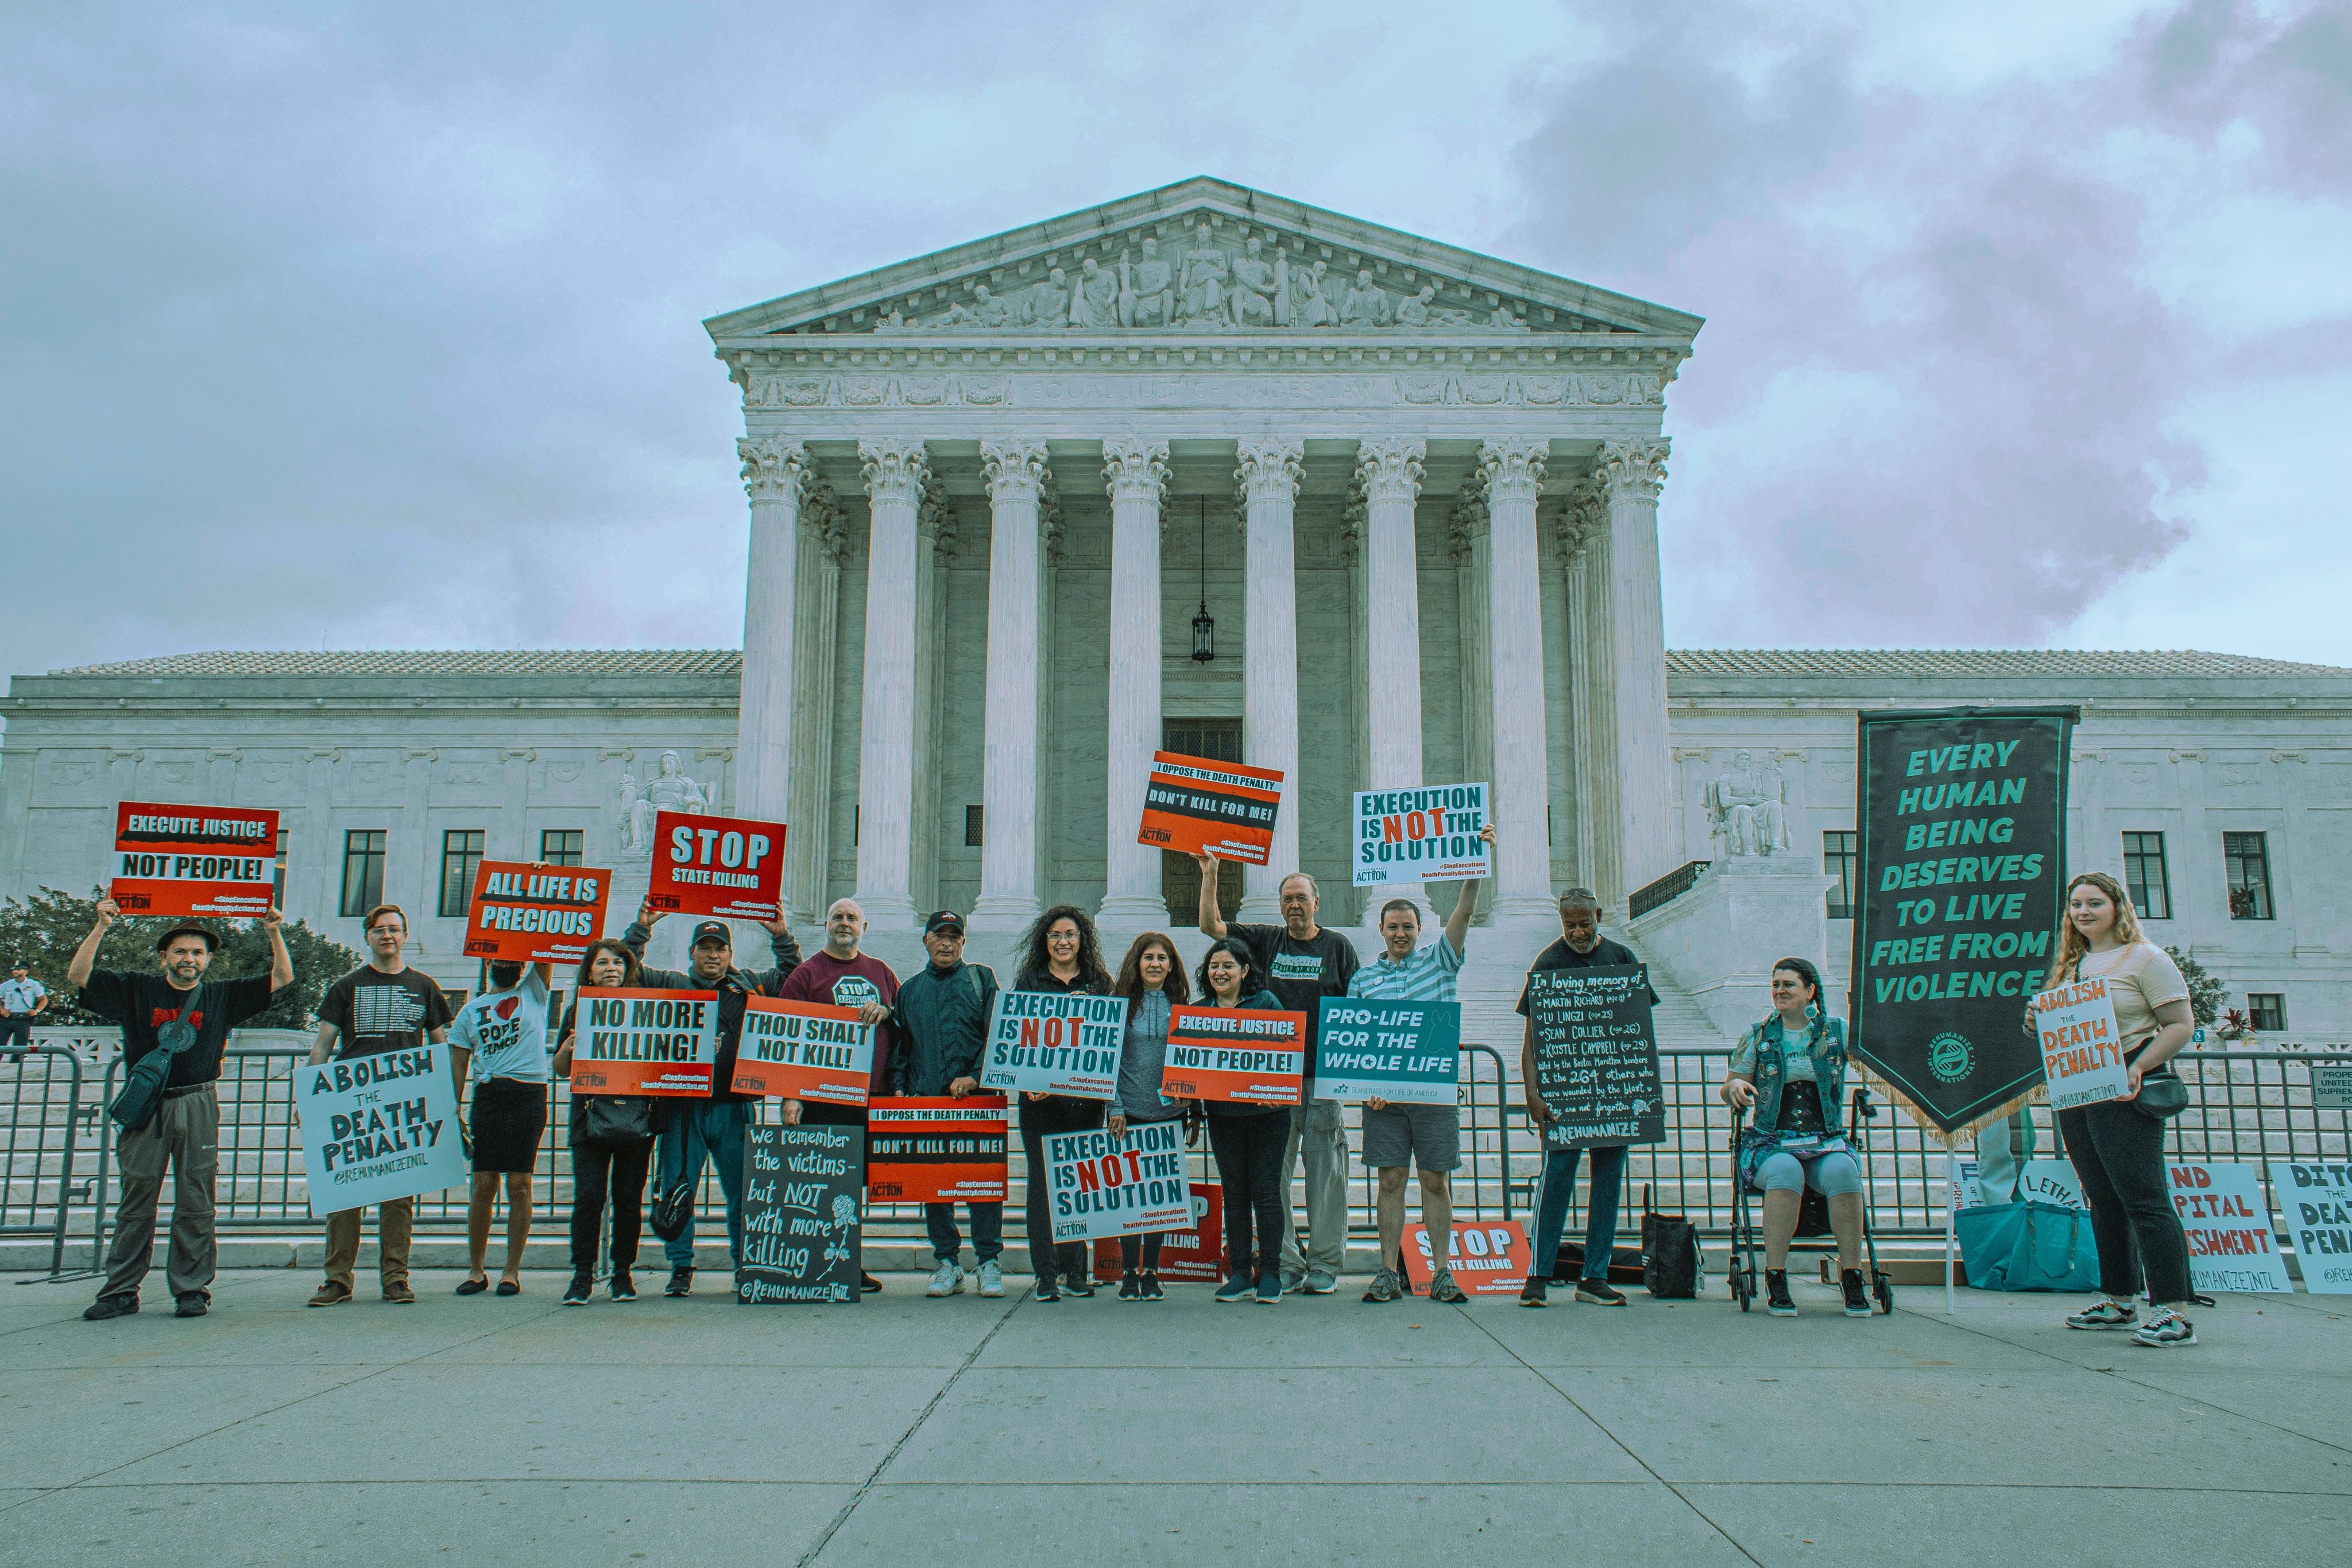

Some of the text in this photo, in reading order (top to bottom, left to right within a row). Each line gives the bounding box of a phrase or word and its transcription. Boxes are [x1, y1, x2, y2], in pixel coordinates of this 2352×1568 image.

[1033, 380, 1375, 400] EQUAL JUSTICE UNDER LAW
[1906, 740, 2020, 777] EVERY
[1157, 764, 1275, 790] I OPPOSE THE DEATH PENALTY
[1149, 789, 1273, 821] DON'T KILL FOR ME!
[1362, 787, 1481, 815] EXECUTION
[1898, 778, 2026, 815] HUMAN
[129, 815, 266, 837] EXECUTE JUSTICE
[1140, 829, 1171, 843] ACTION
[1361, 807, 1481, 845] IS NOT THE
[1905, 817, 2014, 851] BEING
[671, 826, 770, 869] STOP
[1202, 844, 1264, 861] DeathPenaltyAction.org
[1221, 840, 1265, 853] #StopExecutions
[1361, 835, 1483, 864] SOLUTION
[122, 854, 264, 880] NOT PEOPLE!
[672, 868, 759, 889] STATE KILLING
[1356, 870, 1387, 882] ACTION
[1422, 869, 1486, 878] DeathPenaltyAction.org
[1880, 854, 2044, 892] DESERVES
[485, 872, 598, 901] ALL LIFE IS
[480, 905, 593, 936] PRECIOUS
[1897, 893, 2026, 927] TO LIVE
[1870, 931, 2049, 966] FREE FROM
[840, 983, 870, 995] STOP
[1532, 970, 1643, 994] In loving memory of
[1875, 970, 2044, 1003] VIOLENCE
[838, 994, 877, 1004] EXECUTIONS
[1002, 993, 1123, 1023] EXECUTION
[1543, 997, 1571, 1008] MARTIN
[1574, 995, 1603, 1007] RICHARD
[2038, 978, 2106, 1014] ABOLISH
[475, 1005, 493, 1027] I
[589, 1000, 706, 1029] NO MORE
[1179, 1015, 1295, 1035] EXECUTE JUSTICE
[1326, 1008, 1423, 1026] PRO-LIFE
[1544, 1012, 1553, 1024] LU
[1557, 1011, 1584, 1023] LINGZI
[1601, 1010, 1613, 1019] 23)
[2060, 1014, 2076, 1023] THE
[478, 1017, 521, 1044] POPE
[746, 1013, 869, 1046] THOU SHALT
[998, 1017, 1119, 1047] IS NOT THE
[1324, 1031, 1418, 1048] FOR THE
[1545, 1028, 1565, 1041] SEAN
[1572, 1026, 1605, 1039] COLLIER
[1623, 1023, 1641, 1033] 26)
[1929, 1032, 1974, 1051] REHUMANIZE
[2042, 1017, 2108, 1051] DEATH
[590, 1032, 699, 1062] KILLING!
[756, 1039, 853, 1068] NOT KILL!
[994, 1043, 1116, 1074] SOLUTION
[1173, 1047, 1293, 1072] NOT PEOPLE!
[1545, 1043, 1577, 1058] KRYSTLE
[1581, 1041, 1618, 1056] CAMPBELL
[1632, 1039, 1647, 1051] 29)
[2045, 1040, 2121, 1079] PENALTY
[312, 1049, 434, 1095] ABOLISH
[1325, 1052, 1452, 1073] WHOLE LIFE
[1554, 1060, 1560, 1070] by
[1561, 1059, 1571, 1068] the
[1573, 1058, 1592, 1067] Boston
[1623, 1054, 1648, 1064] bombers
[1928, 1058, 1975, 1083] INTERNATIONAL
[1541, 1066, 1654, 1084] & the 264 others who
[353, 1090, 382, 1106] THE
[1562, 1085, 1591, 1097] wounded
[1596, 1085, 1605, 1097] by
[1607, 1082, 1620, 1094] the
[1623, 1081, 1645, 1094] blast
[330, 1097, 427, 1141] DEATH
[1579, 1102, 1591, 1112] not
[1595, 1101, 1630, 1117] forgotten
[781, 1126, 850, 1148] remember
[1548, 1121, 1640, 1144] #REHUMANIZE
[322, 1119, 443, 1172] PENALTY
[753, 1148, 780, 1170] the
[2167, 1166, 2211, 1188] ND
[747, 1178, 828, 1207] but NOT
[2325, 1190, 2347, 1199] THE
[745, 1207, 832, 1237] with more
[742, 1234, 809, 1278] killing
[1426, 1259, 1512, 1271] SATE KILLING
